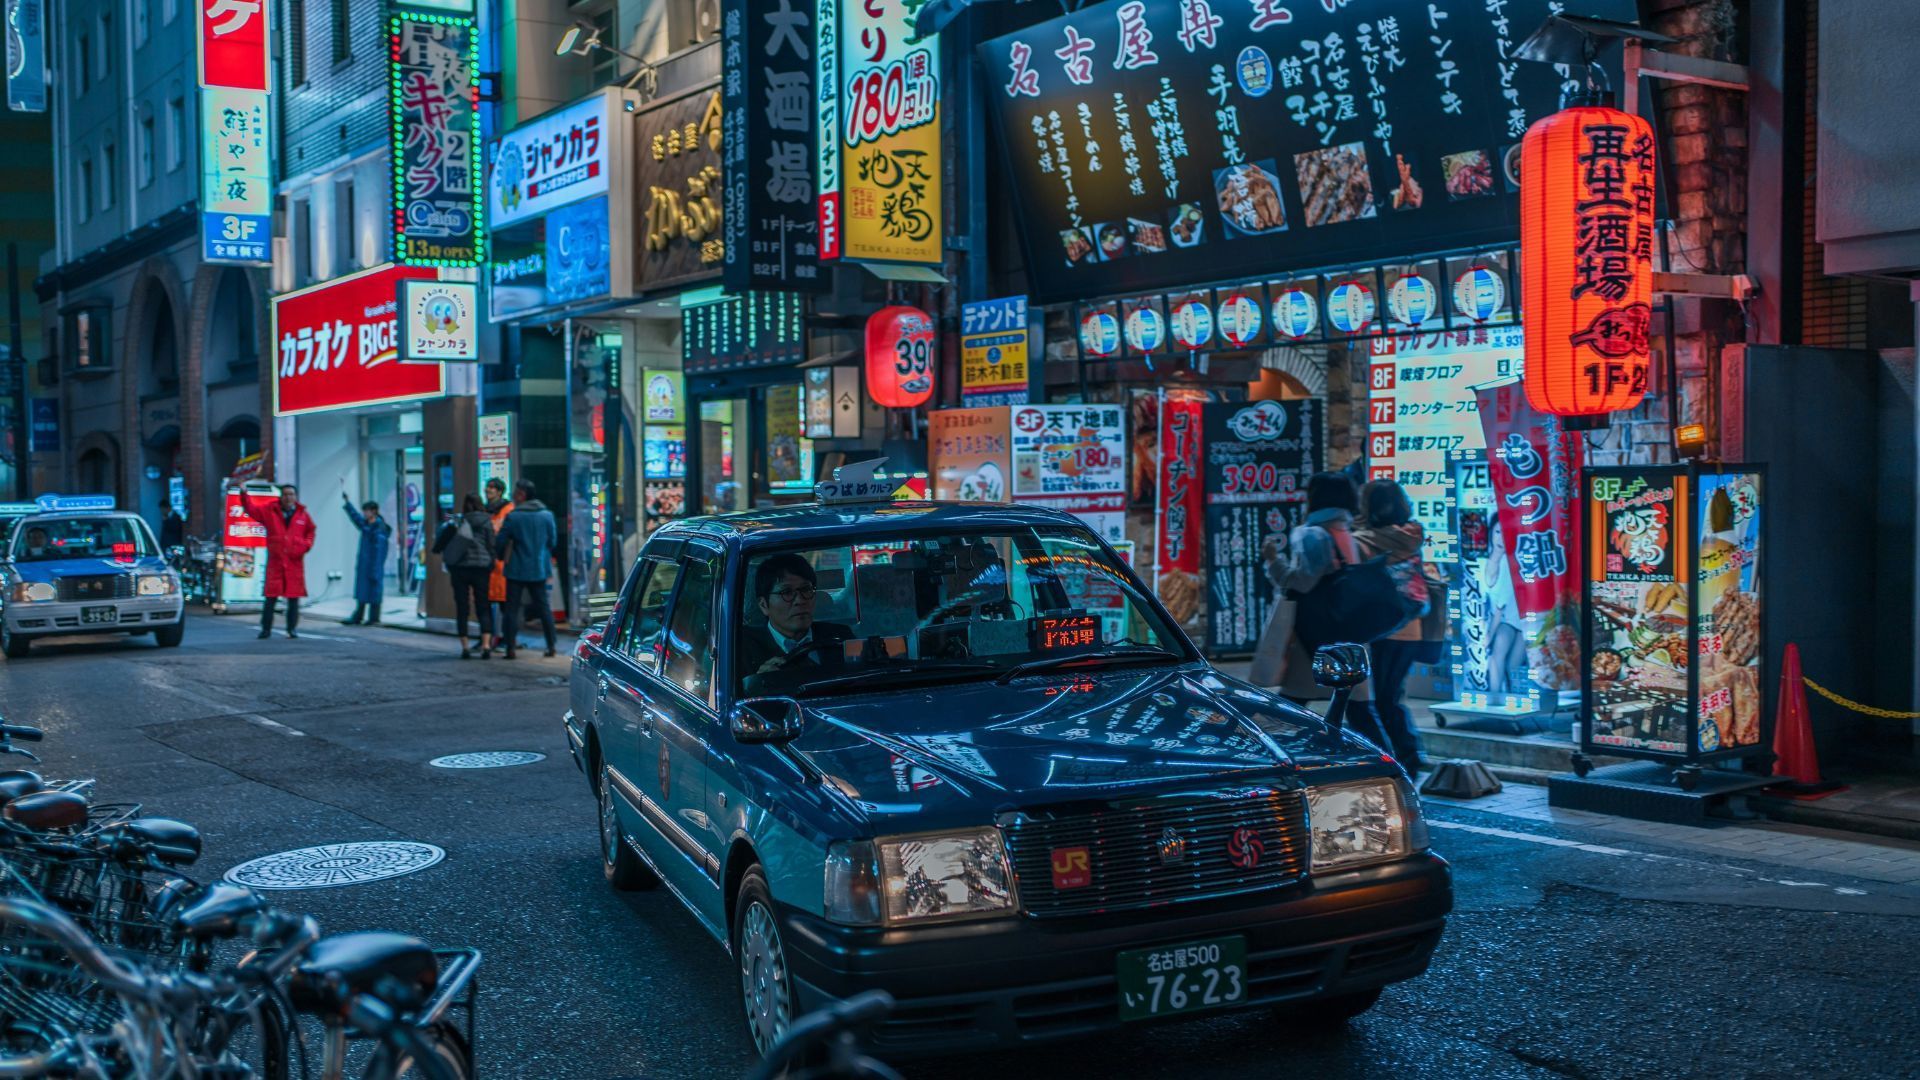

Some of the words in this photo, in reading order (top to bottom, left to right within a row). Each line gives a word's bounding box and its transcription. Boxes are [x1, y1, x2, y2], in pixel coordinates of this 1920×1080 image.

[1377, 16, 1406, 72] 特大
[1429, 3, 1462, 115] トンテキ
[763, 0, 811, 204] 大酒場
[848, 66, 903, 140] 180
[1278, 56, 1310, 126] 餃子
[1300, 40, 1337, 145] コーチン
[1323, 32, 1358, 120] 名古屋
[526, 115, 599, 178] ジャンカラ
[221, 215, 258, 241] 3F
[761, 218, 780, 231] 1F
[821, 200, 836, 253] 3F
[1573, 126, 1633, 300] 再生酒場
[964, 302, 1015, 333] テナント
[280, 320, 352, 378] カラオケ
[1373, 367, 1393, 388] 8F
[1019, 412, 1042, 430] 3F
[1046, 410, 1120, 430] 天下地鶏
[1373, 402, 1392, 422] 7F
[1372, 436, 1392, 456] 6F
[1166, 411, 1190, 561] コーチン餃子
[1502, 433, 1568, 579] もつ鍋
[1594, 477, 1620, 500] 3F
[1053, 850, 1089, 874] JR
[1148, 944, 1220, 972] 名古屋500
[1125, 991, 1144, 1008] い
[1147, 965, 1242, 1013] 76-23
